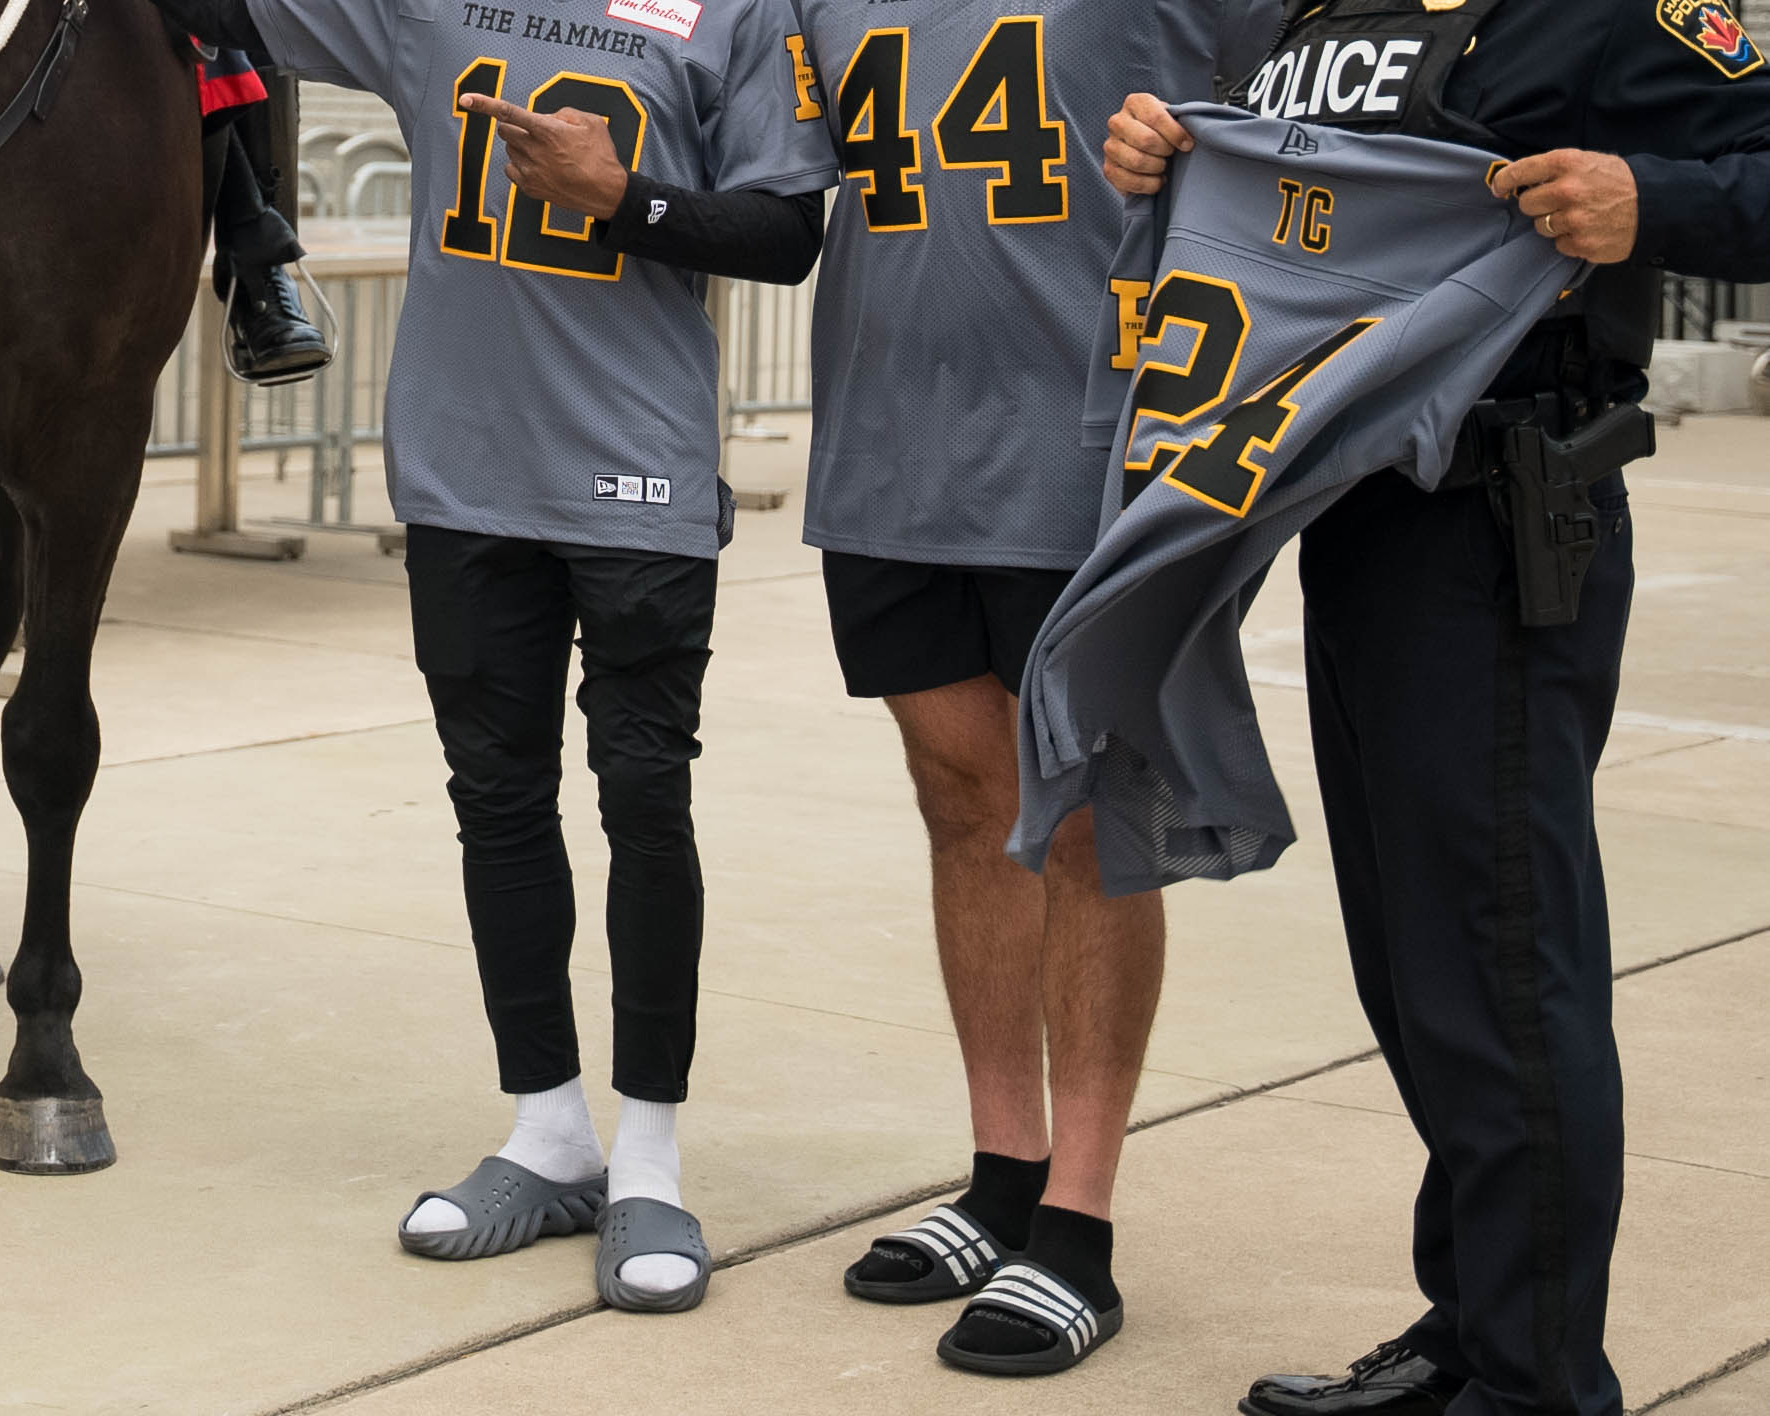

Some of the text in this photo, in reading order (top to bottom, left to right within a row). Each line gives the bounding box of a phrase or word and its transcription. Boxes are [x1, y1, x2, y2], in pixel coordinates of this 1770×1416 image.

[462, 4, 648, 60] THE HAMMER
[640, 0, 694, 29] Hortons
[1248, 39, 1423, 119] POLICE
[837, 15, 1069, 233] 44
[1272, 176, 1335, 255] TC
[1122, 269, 1385, 518] 24
[652, 482, 666, 500] M
